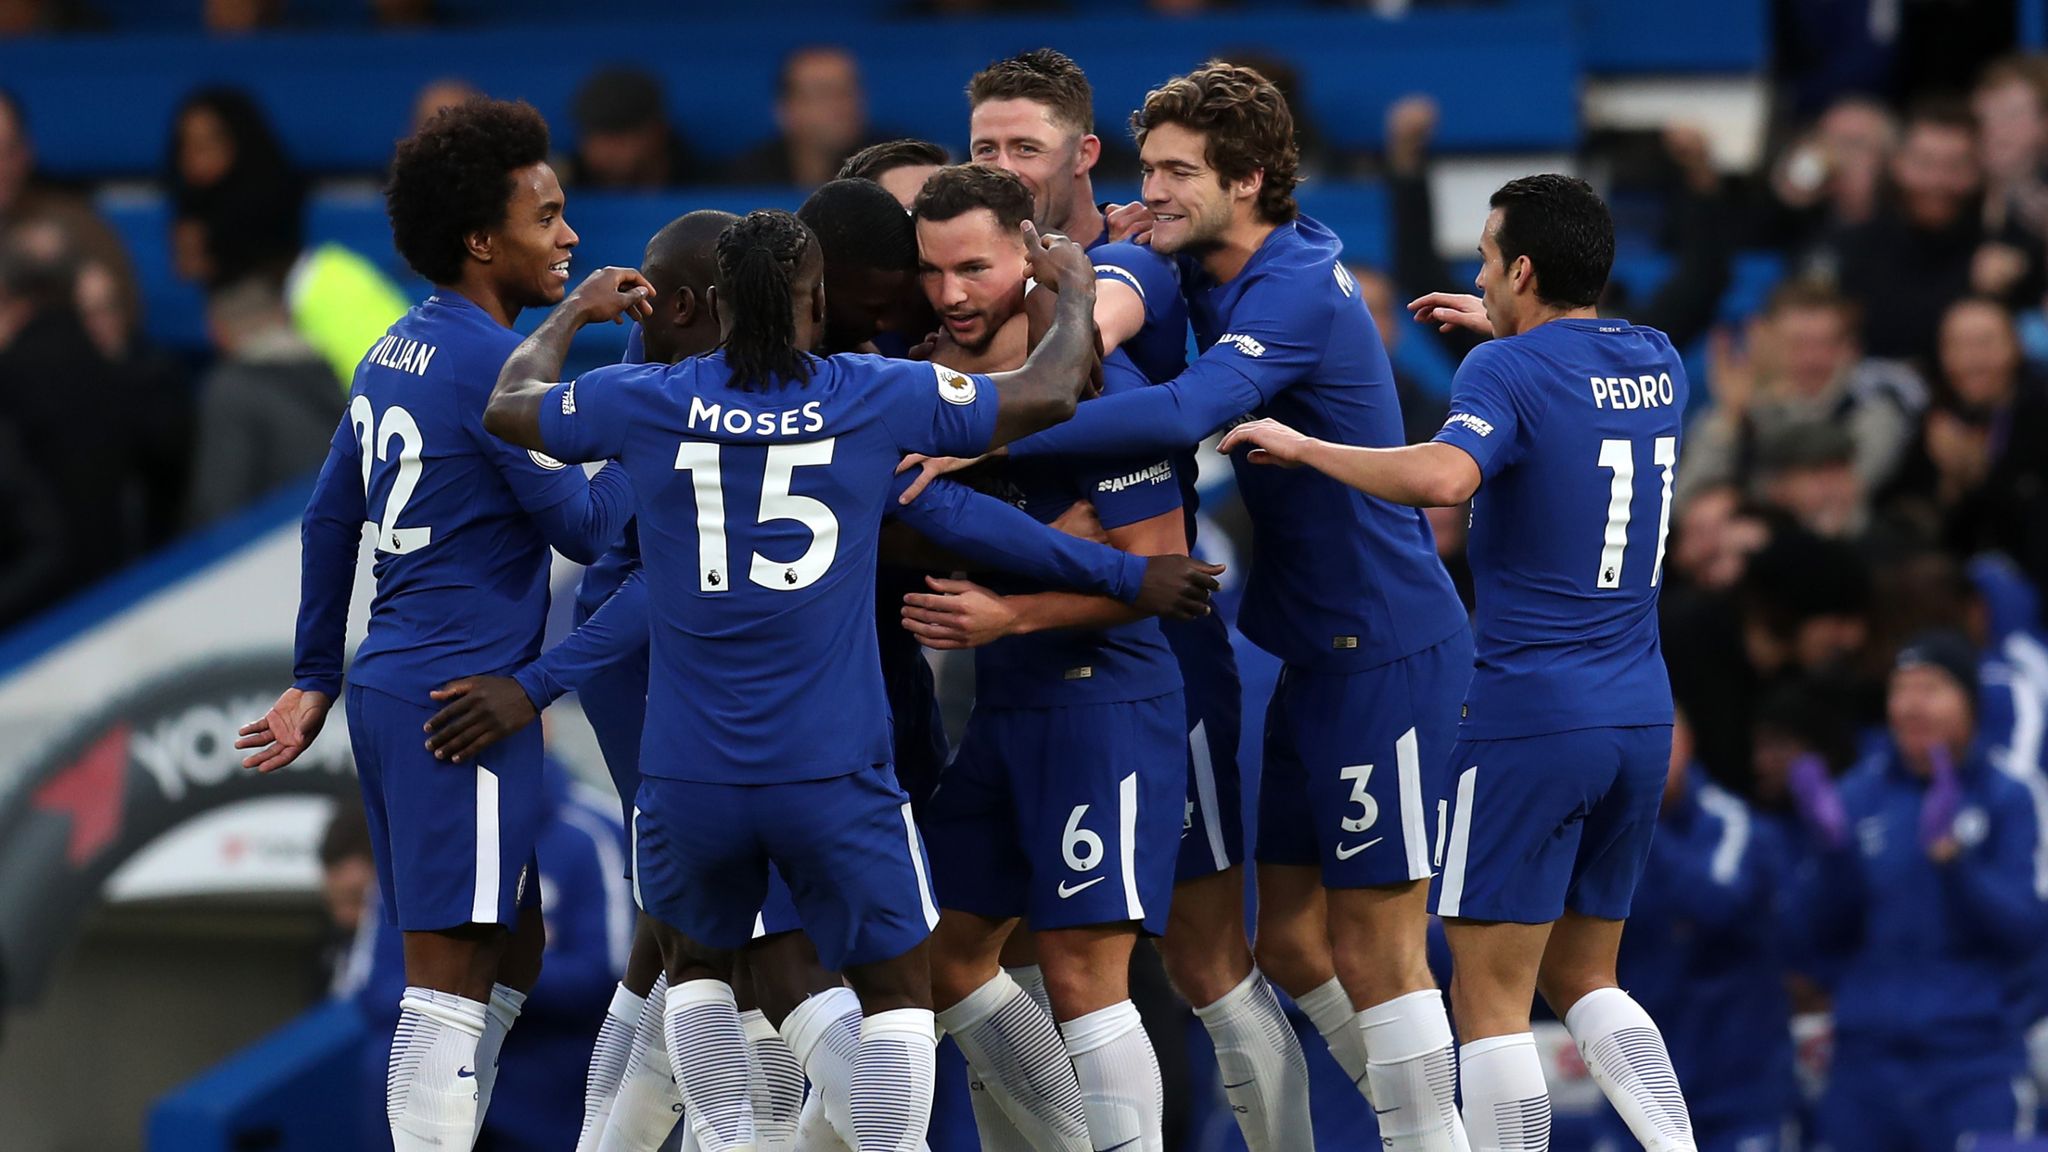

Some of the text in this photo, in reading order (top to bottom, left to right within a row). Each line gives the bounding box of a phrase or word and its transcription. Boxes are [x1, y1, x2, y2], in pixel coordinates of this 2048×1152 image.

[688, 396, 824, 436] MOSES
[1590, 372, 1674, 410] PEDRO
[1111, 460, 1171, 493] ALLIANCE
[1150, 470, 1172, 486] TYRES
[674, 437, 840, 591] 15
[1597, 437, 1676, 588] 11
[1340, 764, 1379, 833] 3
[1062, 804, 1104, 872] 6
